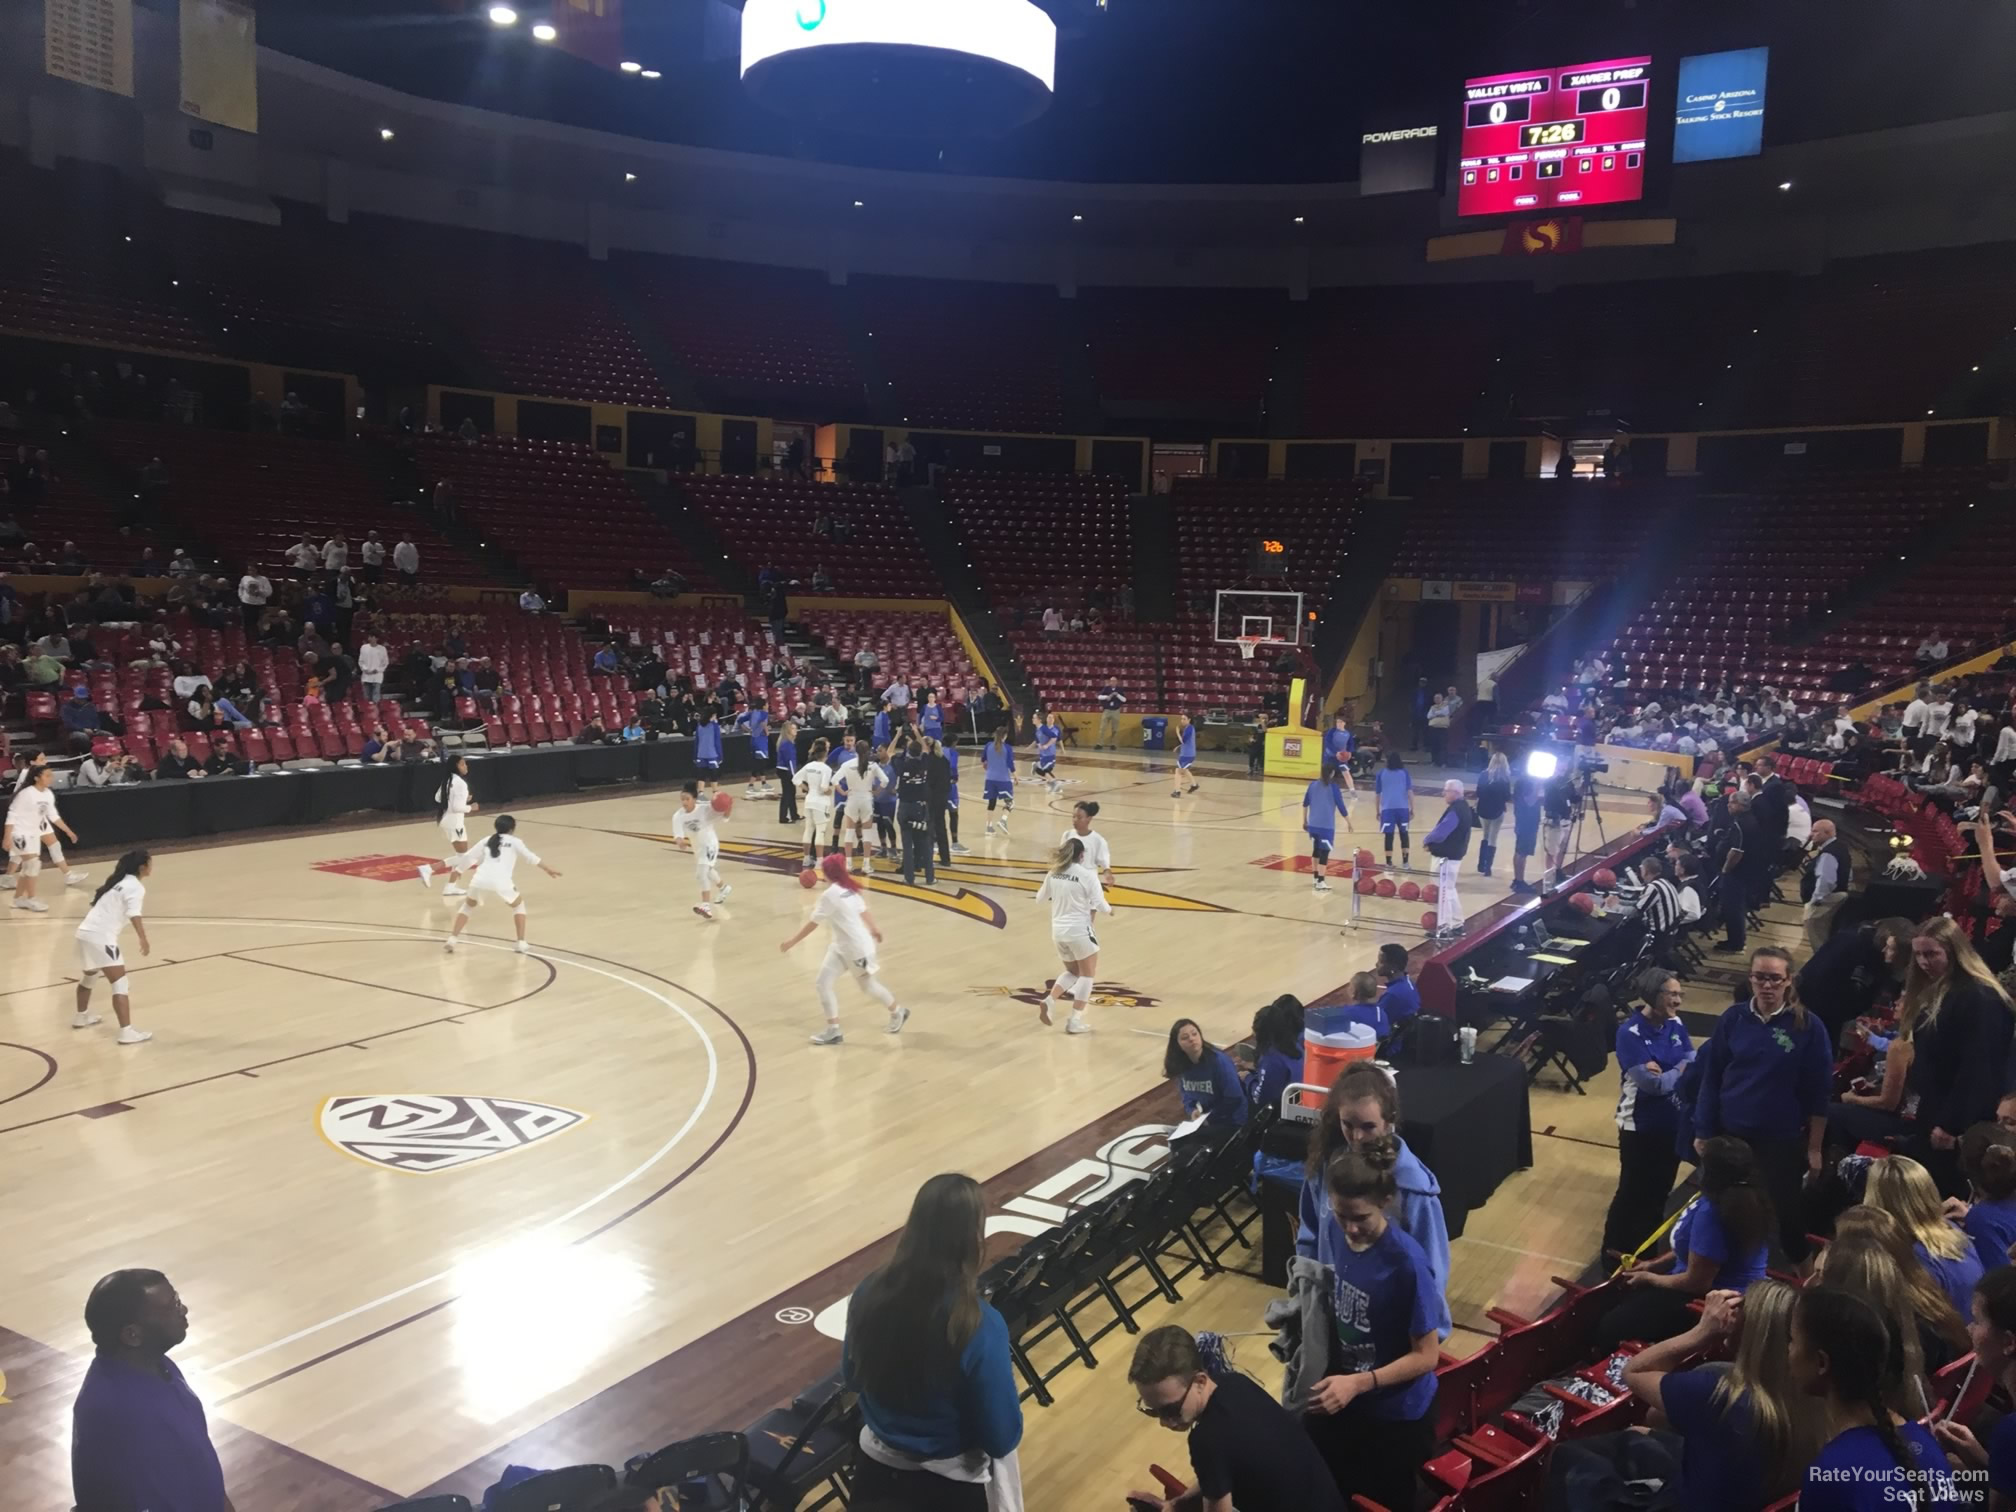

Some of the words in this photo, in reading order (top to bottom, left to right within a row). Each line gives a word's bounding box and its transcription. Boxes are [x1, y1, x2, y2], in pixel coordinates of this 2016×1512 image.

[1571, 71, 1612, 86] XAVIER
[1614, 68, 1644, 81] PREP
[1467, 85, 1507, 99] VALLEY
[1509, 81, 1541, 93] VISTA
[1602, 88, 1621, 110] 0
[1489, 101, 1507, 124] 0
[1362, 125, 1438, 144] POWERADE
[1528, 123, 1576, 145] 7:26
